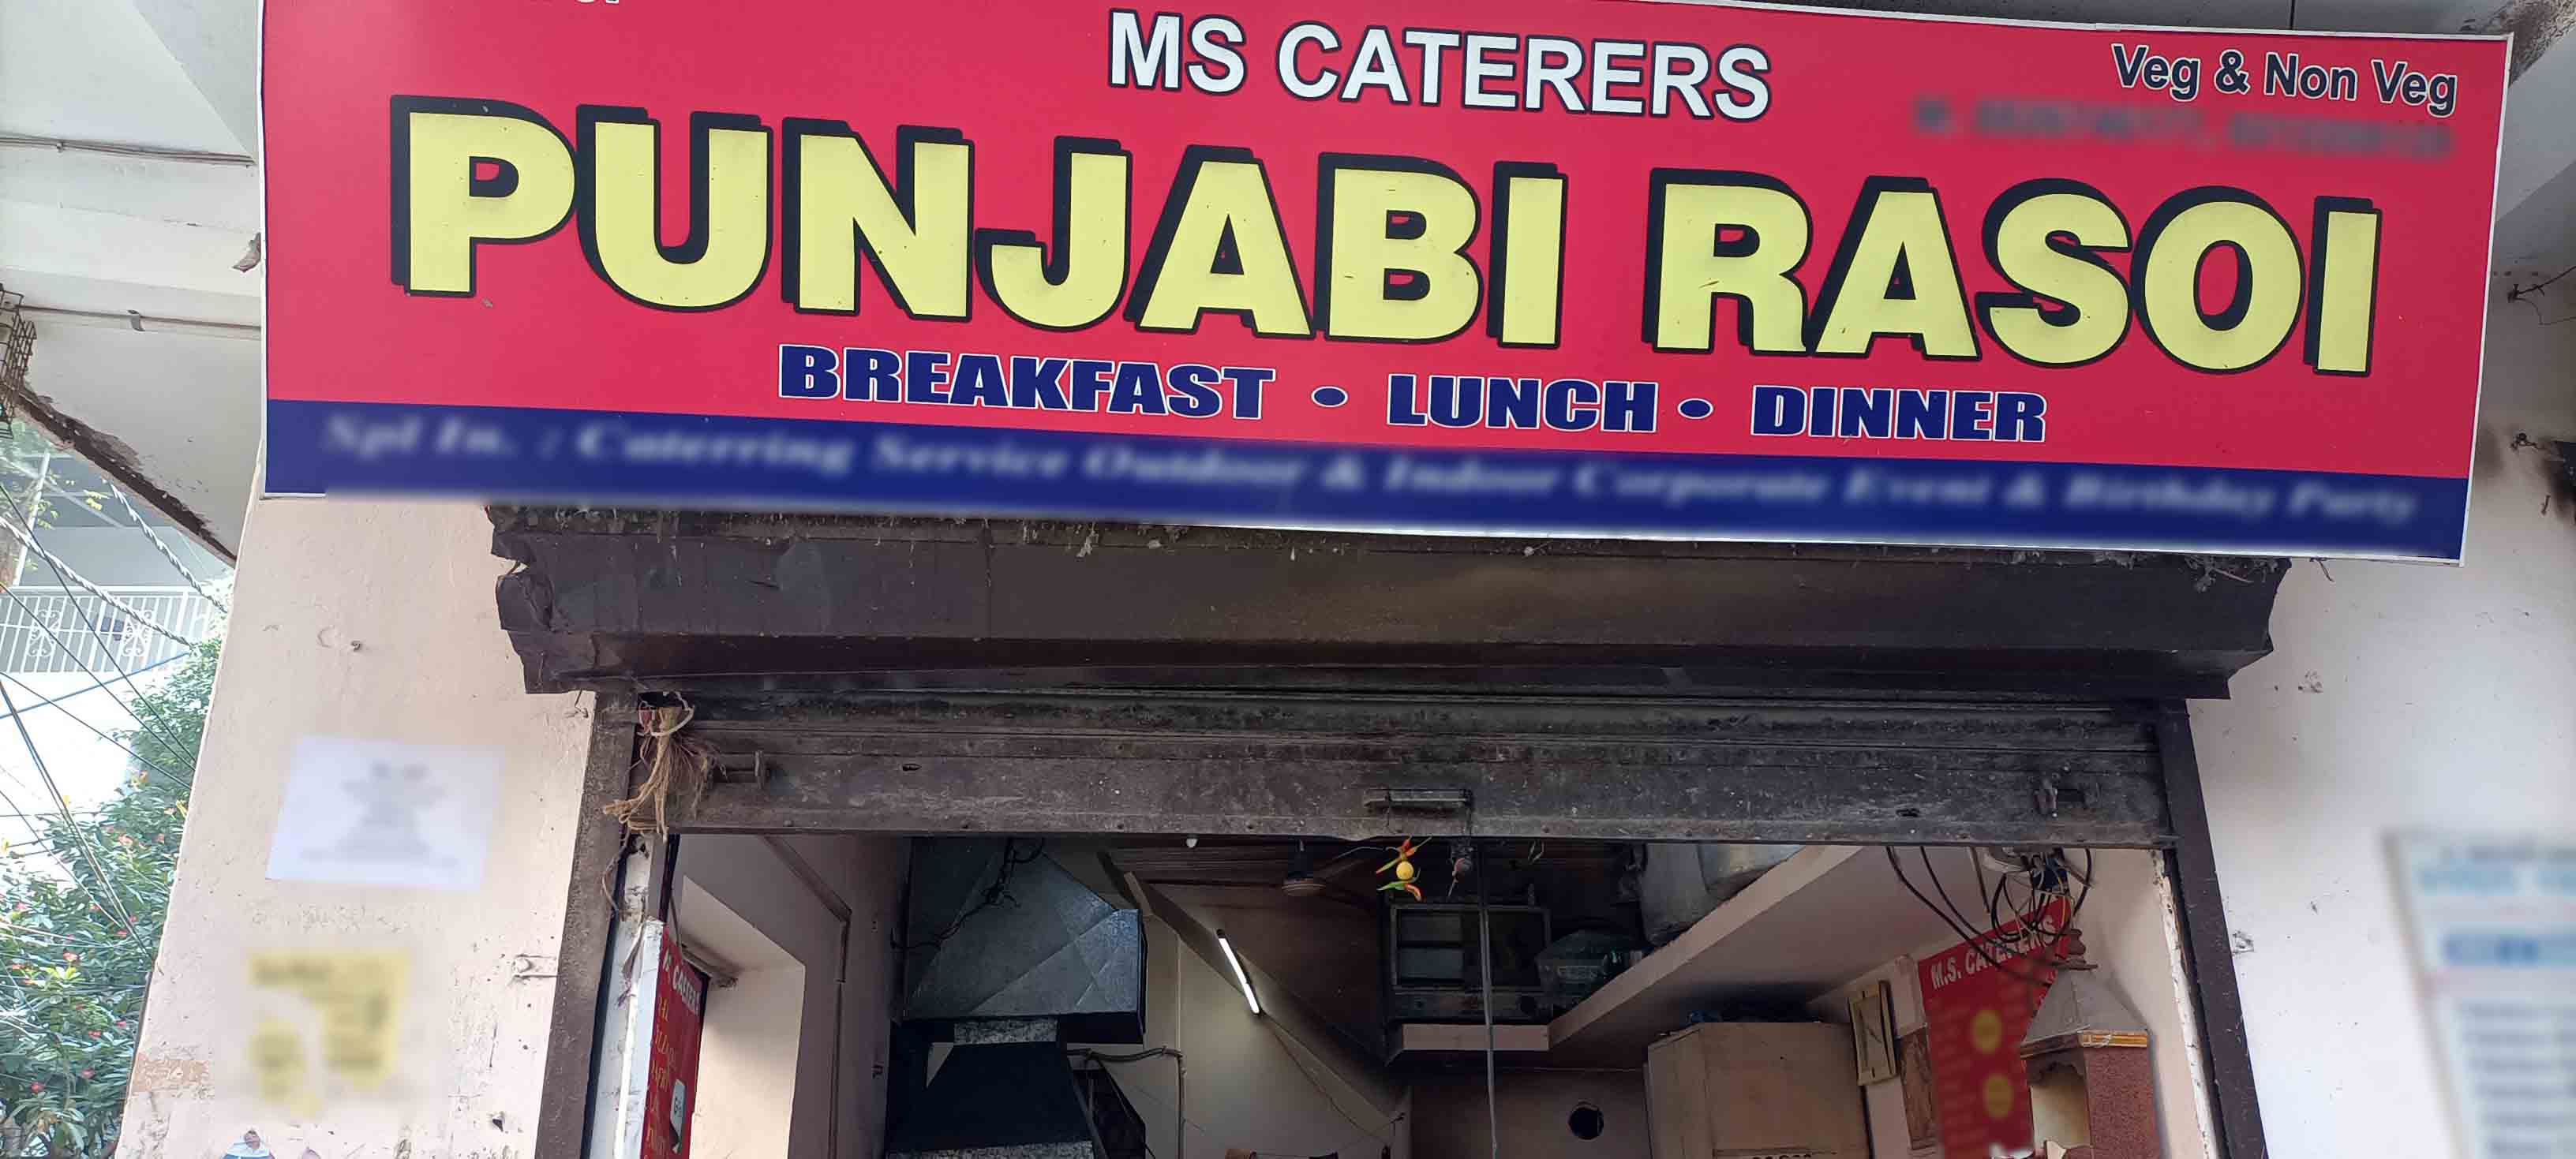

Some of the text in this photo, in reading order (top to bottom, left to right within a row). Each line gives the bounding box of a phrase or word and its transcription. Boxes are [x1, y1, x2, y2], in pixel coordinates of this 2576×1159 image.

[1108, 8, 1773, 121] MS CATERERS
[2111, 43, 2458, 118] Veg & Non Veg
[390, 94, 2382, 376] PUNJABI RASOI
[778, 344, 2048, 443] BREAKFAST LUNCH DINNER
